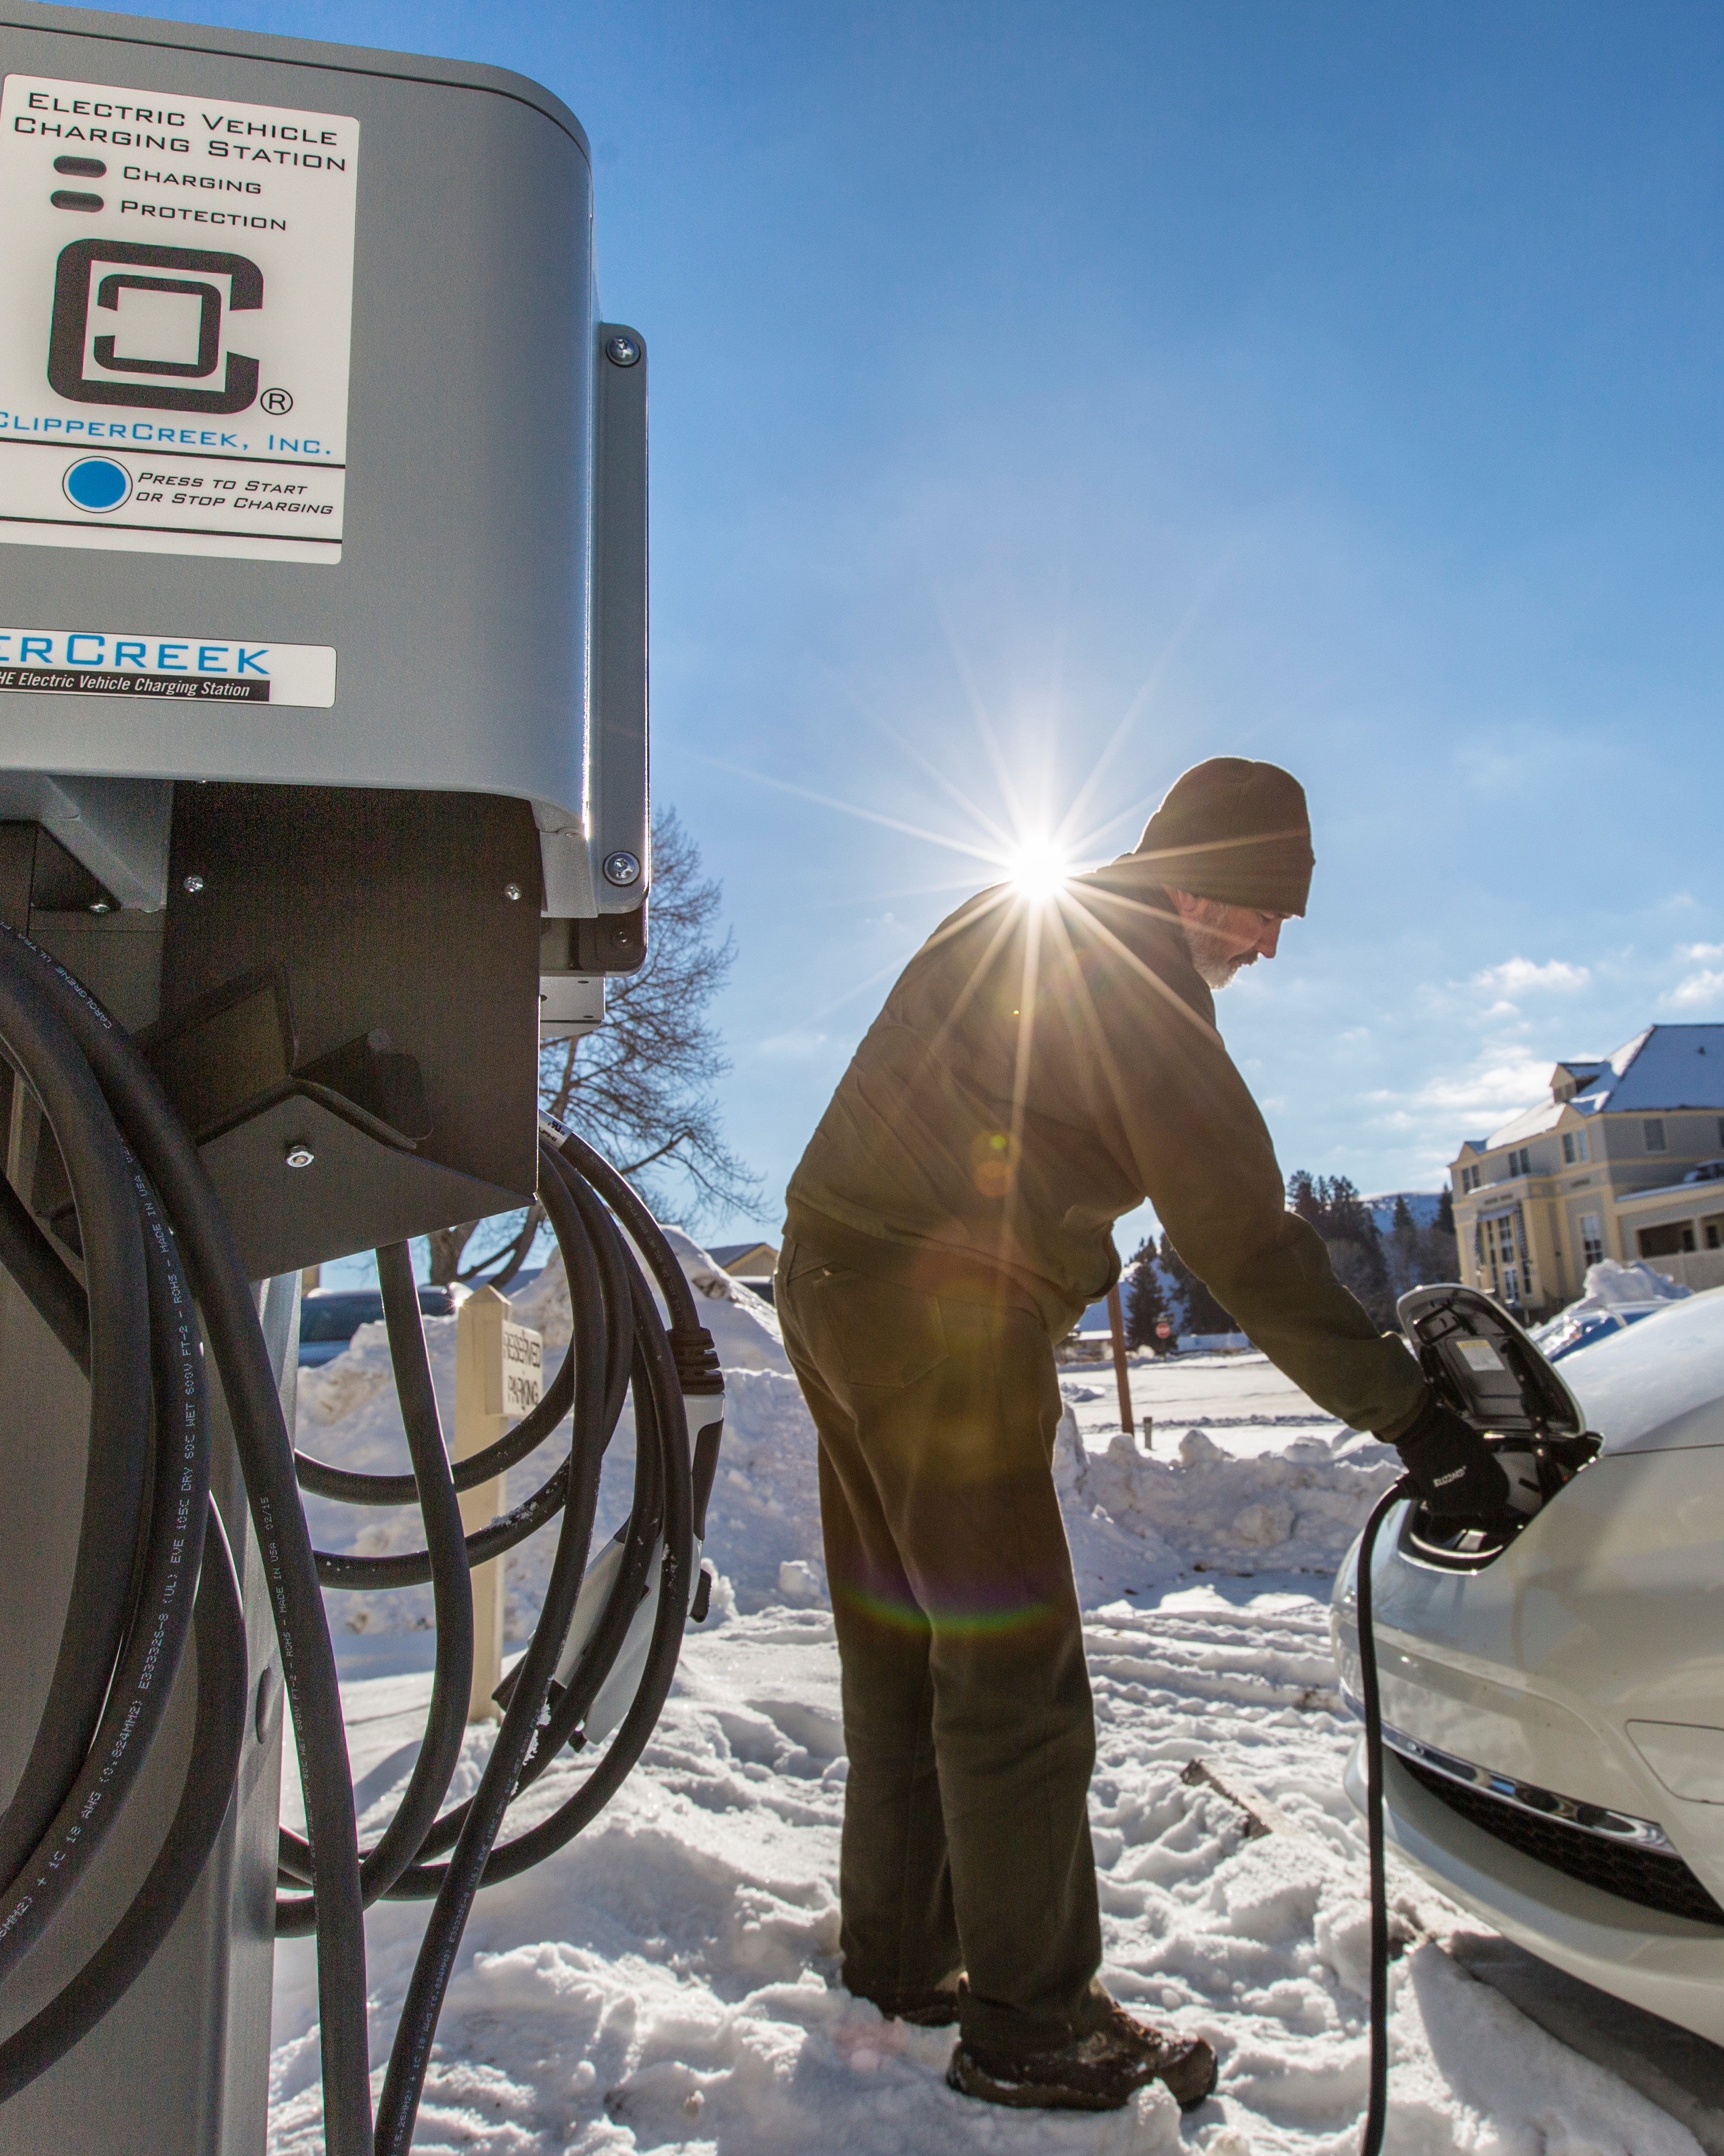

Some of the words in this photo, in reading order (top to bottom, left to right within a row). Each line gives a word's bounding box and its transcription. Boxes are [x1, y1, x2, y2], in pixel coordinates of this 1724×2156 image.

[29, 92, 185, 126] ELECTRIC
[202, 114, 338, 146] VEHICLE
[15, 117, 190, 152] CHARGING
[208, 141, 346, 171] STATION
[124, 166, 262, 194] CHARGING
[121, 201, 286, 231] PROTECTION
[269, 434, 331, 455] INC.
[138, 472, 203, 487] PRESS
[213, 479, 236, 490] TO
[245, 480, 307, 495] START
[136, 491, 163, 503] OR
[172, 494, 225, 507] STOP
[234, 497, 333, 515] CHARGING
[18, 672, 74, 689] Electric
[79, 675, 130, 691] Vehicle
[135, 678, 198, 697] Charging
[201, 681, 250, 697] Station
[134, 1175, 148, 1197] USA
[145, 1203, 156, 1216] IN
[152, 1223, 169, 1254] MADE
[179, 1325, 191, 1357] FT-2
[185, 1402, 196, 1427] WET
[269, 1542, 279, 1562] USA
[273, 1567, 282, 1580] IN
[276, 1586, 287, 1613] MADE
[290, 1675, 299, 1700] FT-2
